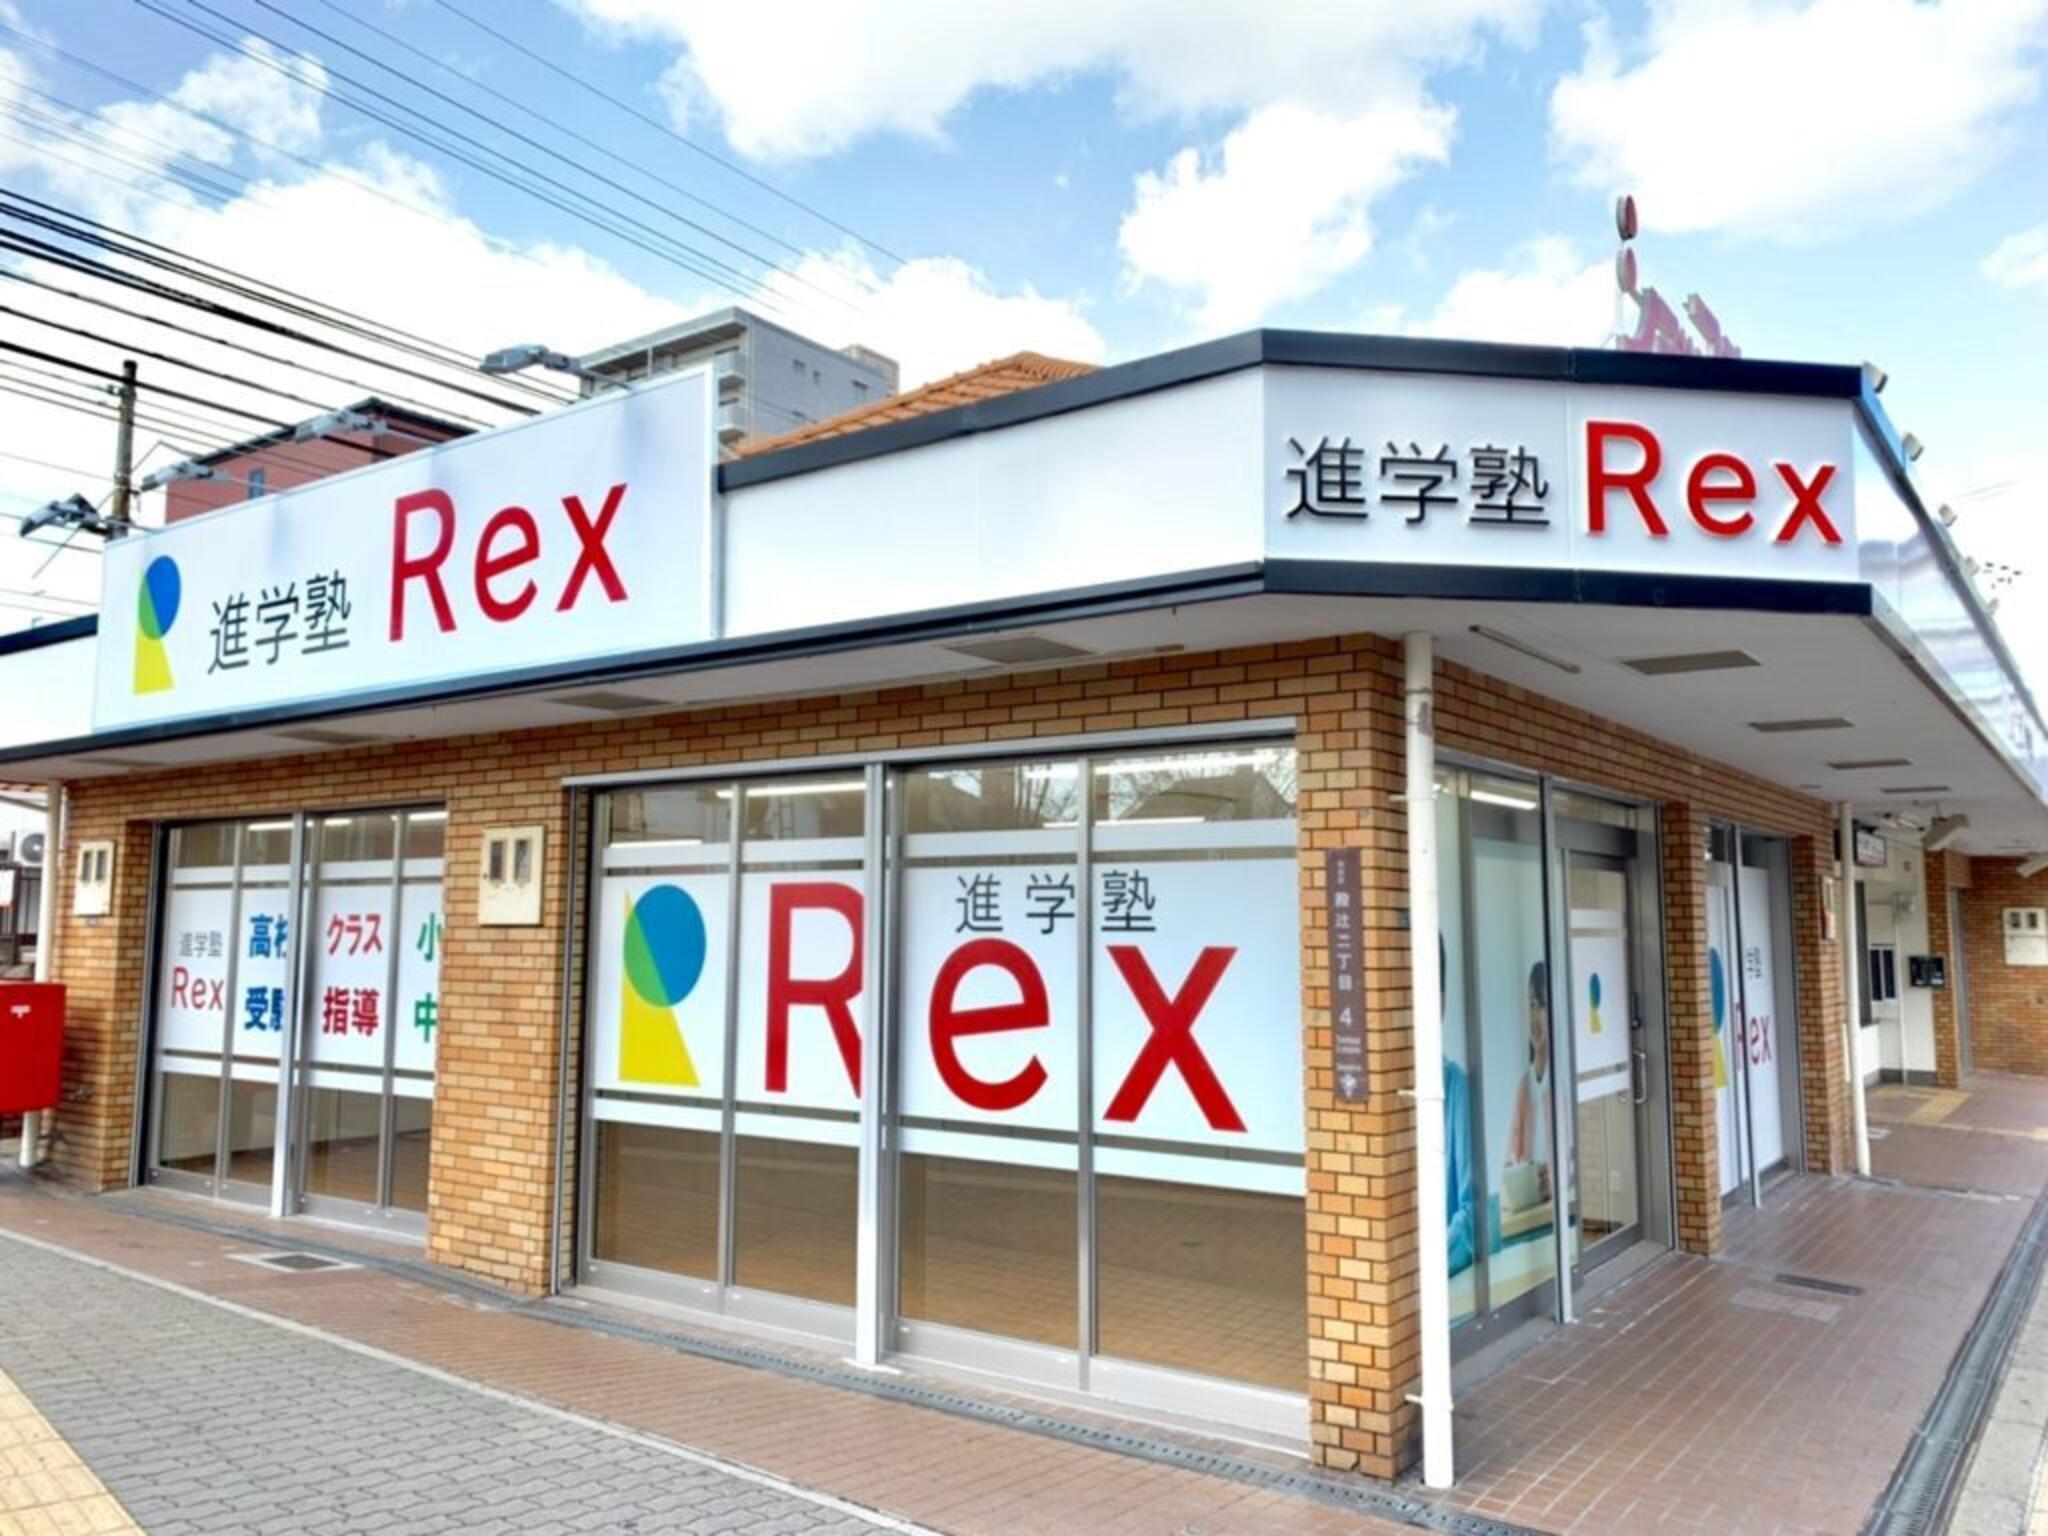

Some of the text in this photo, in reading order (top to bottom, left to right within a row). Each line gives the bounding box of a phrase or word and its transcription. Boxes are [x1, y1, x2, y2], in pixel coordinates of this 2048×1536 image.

[1286, 420, 1843, 545] 進学塾 Rex
[208, 482, 628, 675] 進学塾 Rex
[955, 868, 1157, 934] 進学塾
[327, 914, 383, 956] クラス
[171, 966, 225, 1012] Rex
[322, 986, 380, 1037] 指導
[415, 992, 438, 1044] 中
[764, 881, 1248, 1133] Rex
